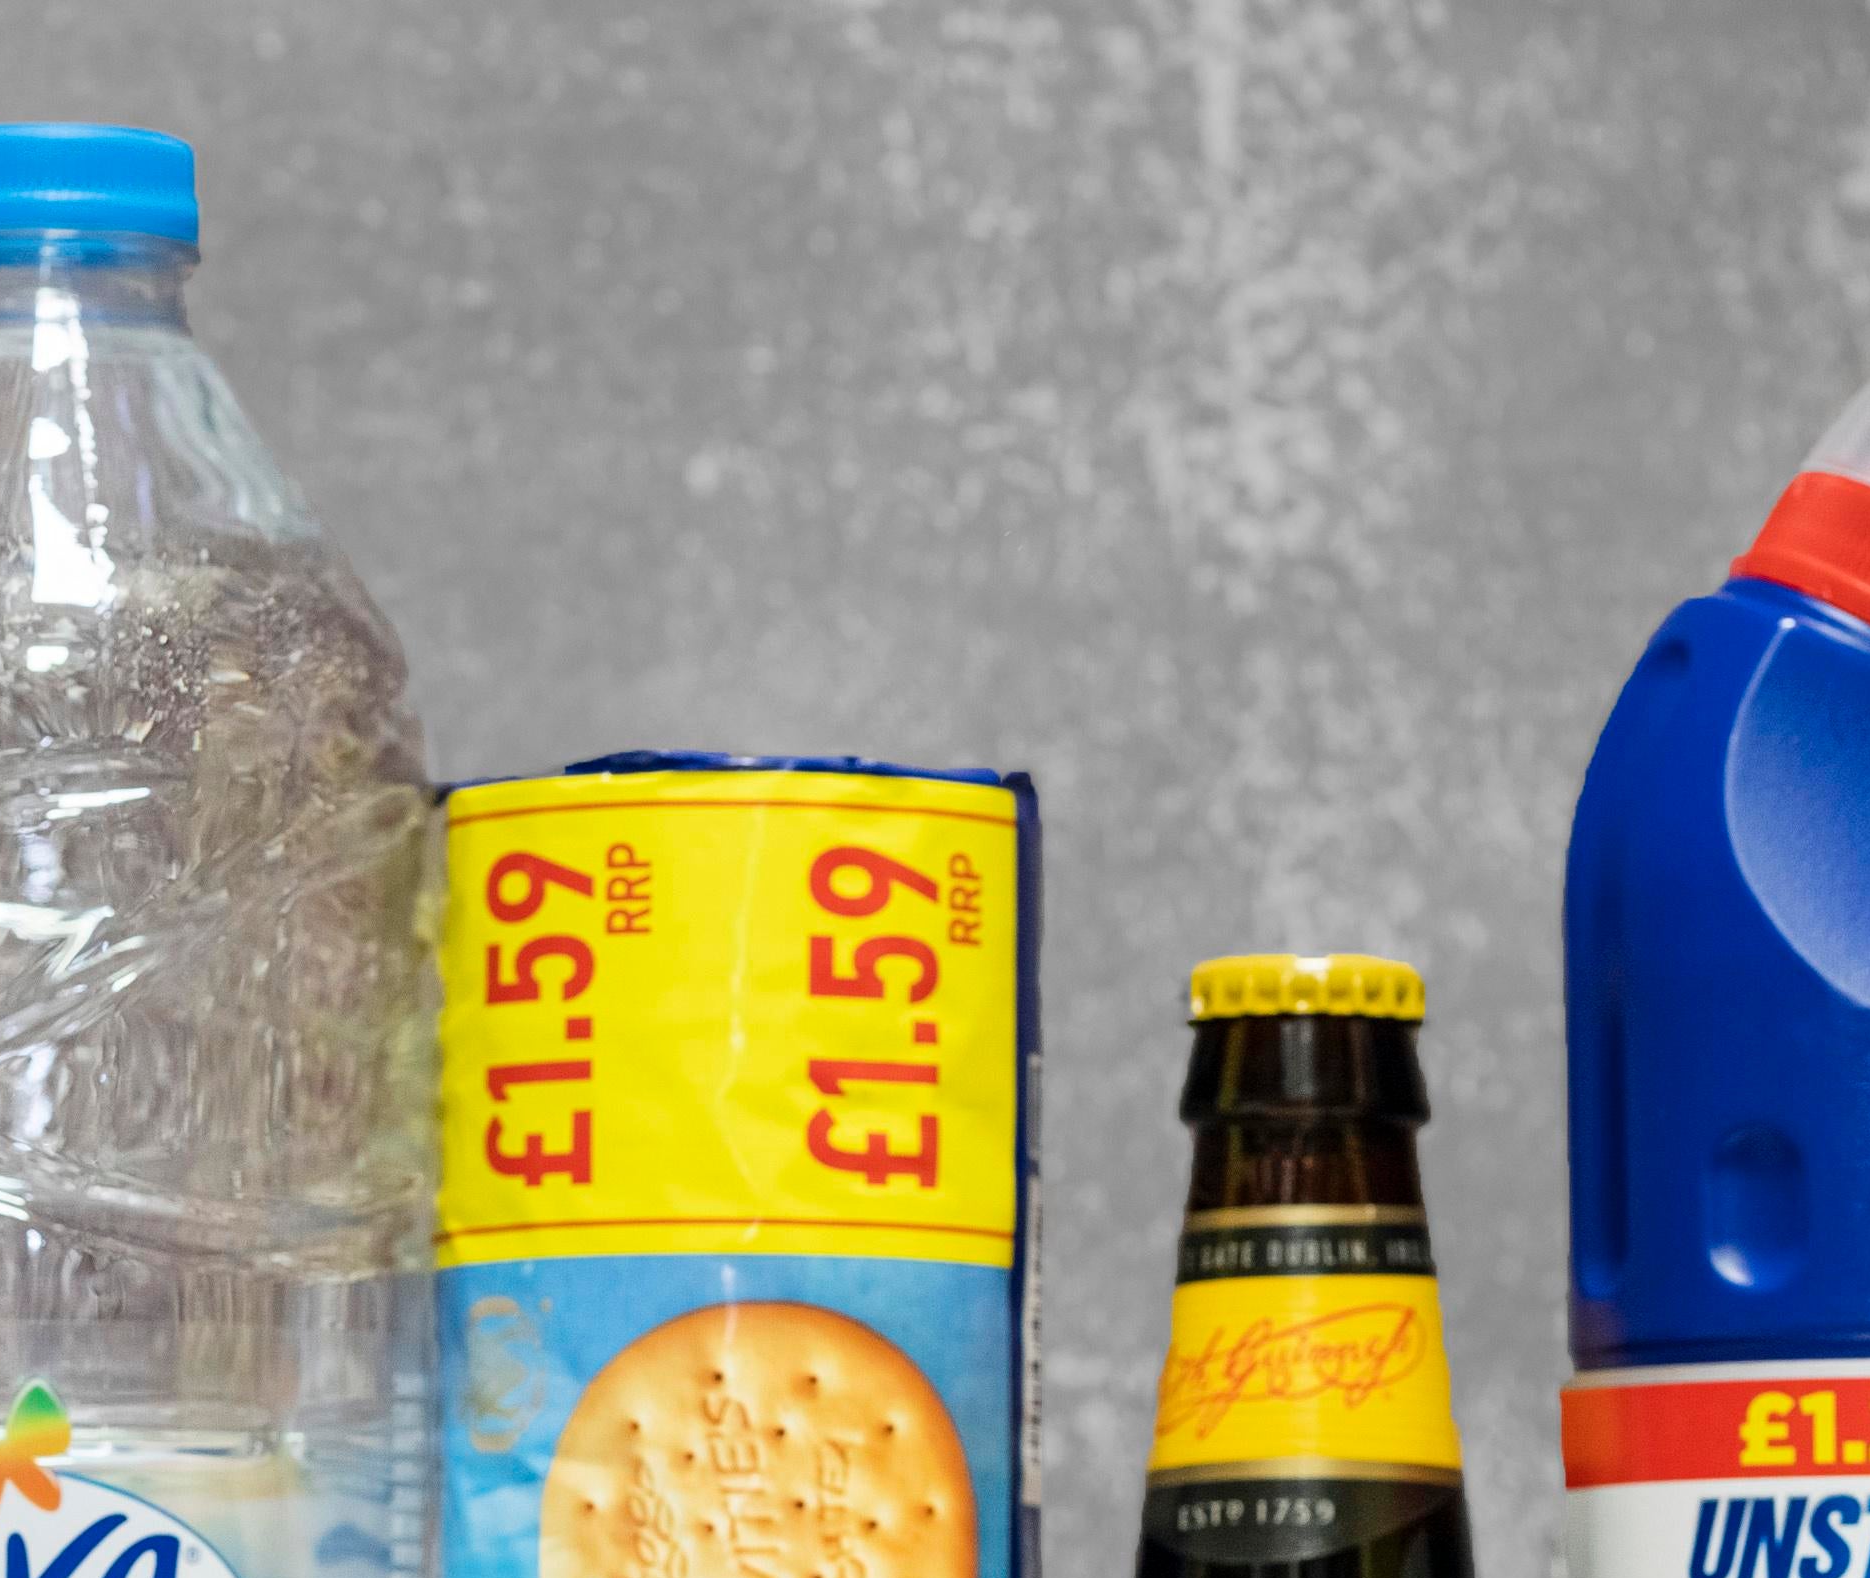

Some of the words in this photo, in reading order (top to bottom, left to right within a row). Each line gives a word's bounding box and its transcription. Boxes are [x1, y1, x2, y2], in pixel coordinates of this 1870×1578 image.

[606, 843, 651, 936] RRP
[949, 853, 983, 948] RRP
[484, 851, 595, 1188] £1.59
[807, 845, 940, 1189] £1.59
